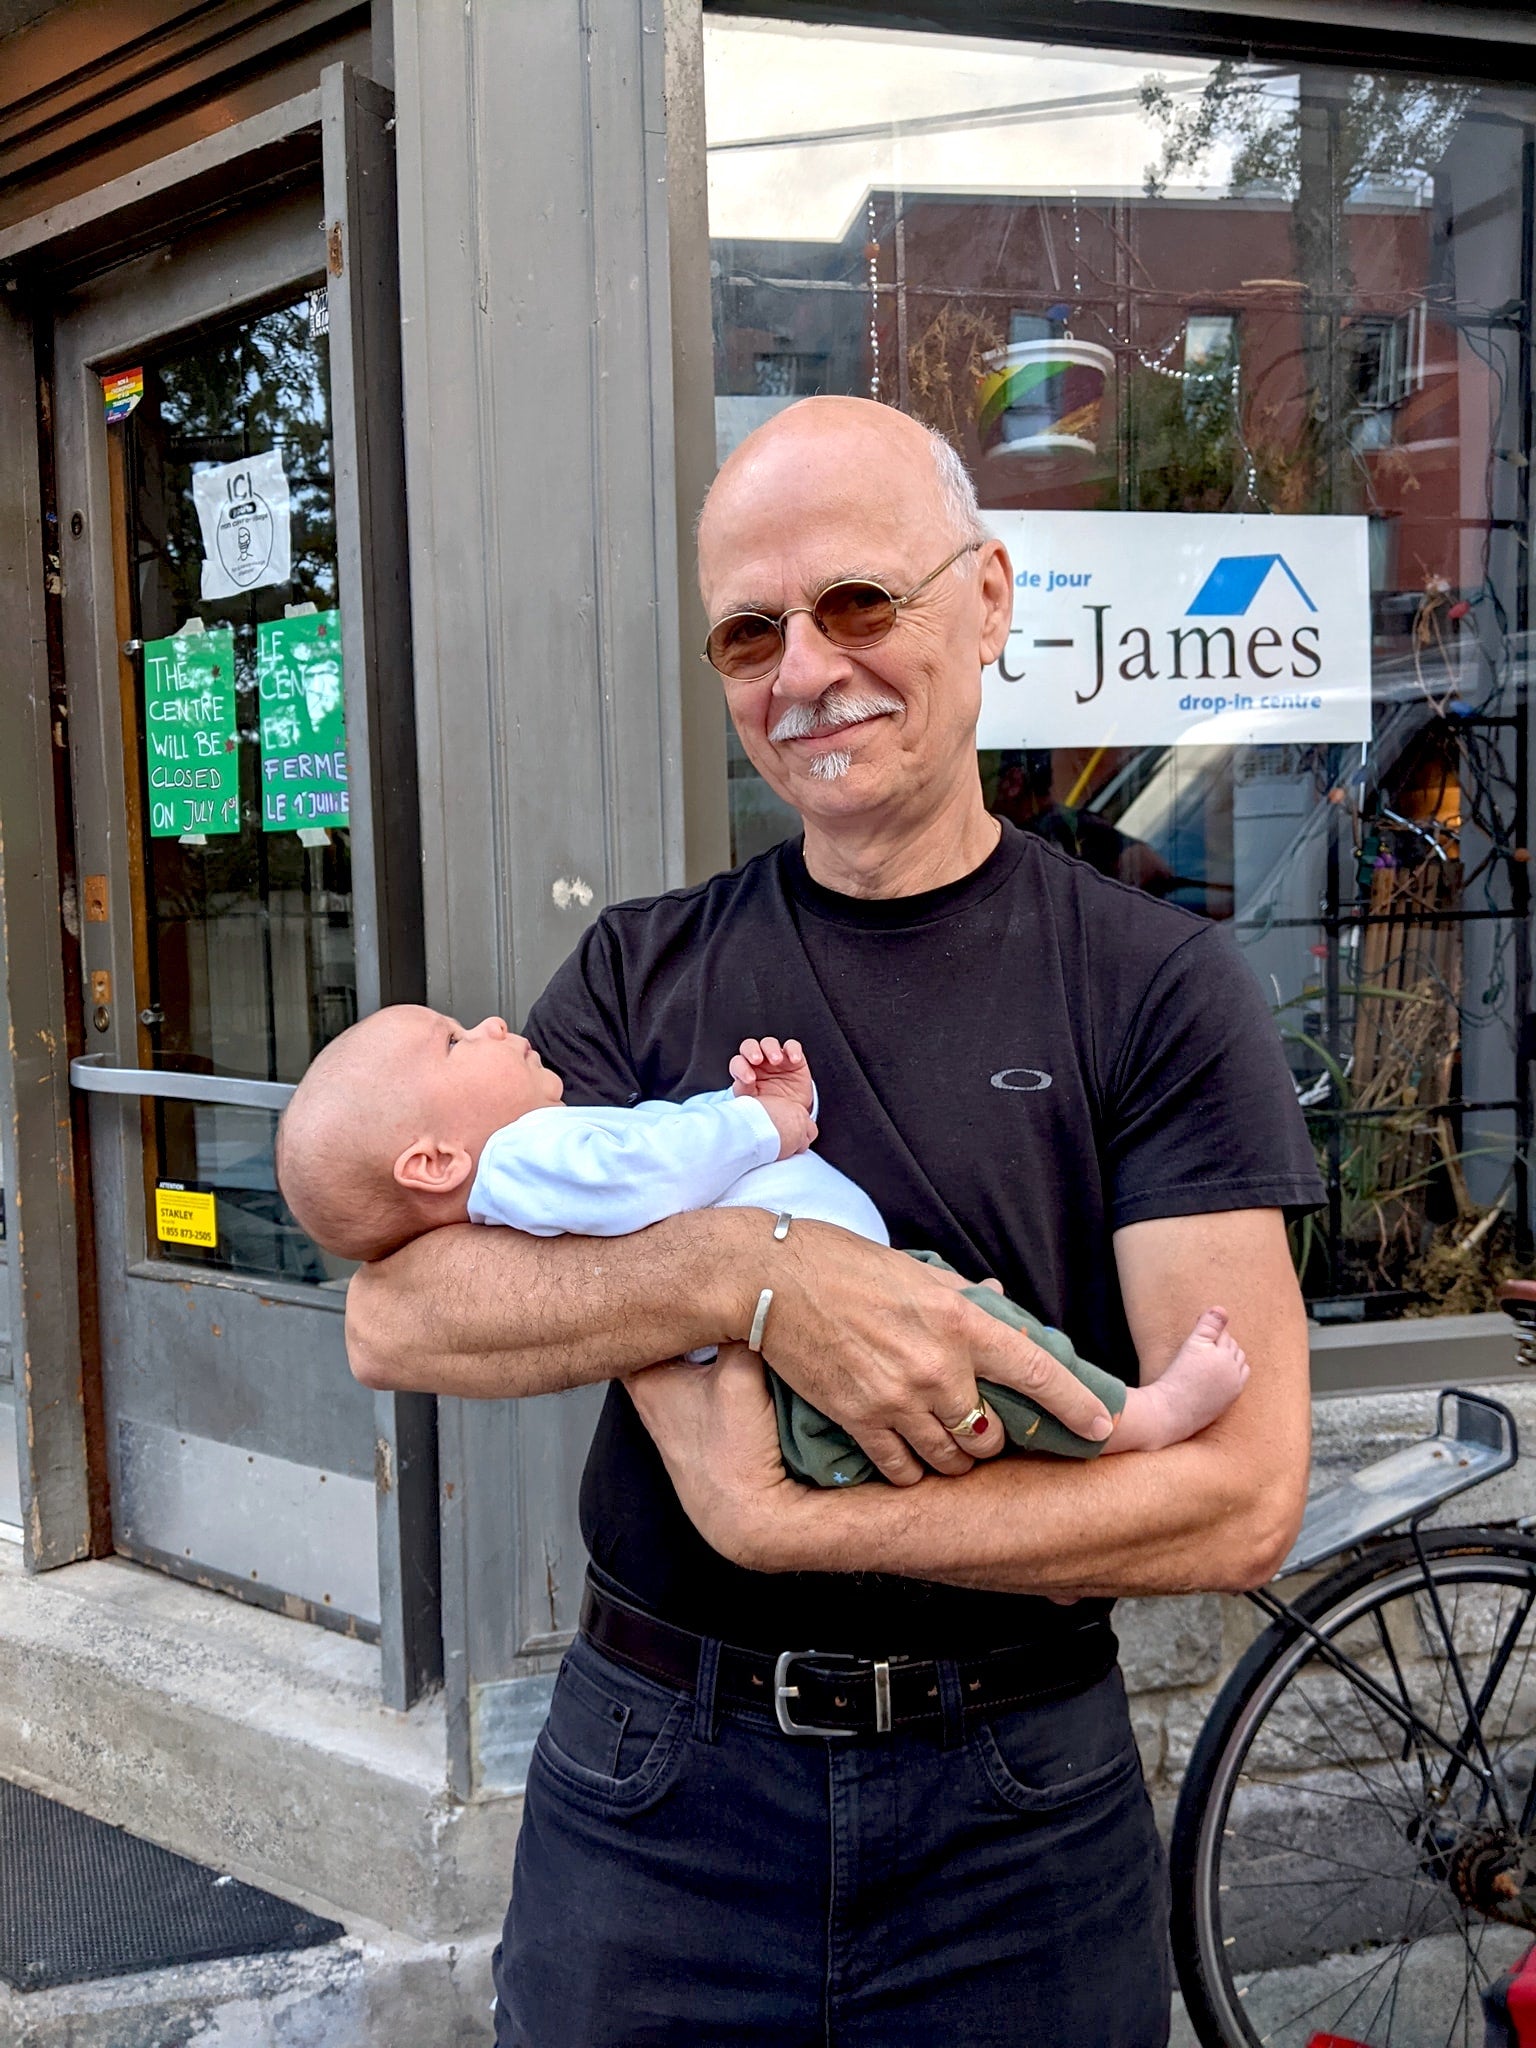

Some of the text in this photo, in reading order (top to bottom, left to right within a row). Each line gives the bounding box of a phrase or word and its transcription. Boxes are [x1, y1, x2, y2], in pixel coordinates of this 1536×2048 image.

[227, 472, 253, 502] ICI
[1015, 571, 1092, 592] de jour
[260, 631, 284, 662] LE
[998, 604, 1322, 705] t-James
[148, 656, 191, 692] THE
[149, 696, 224, 721] CENTRE
[1179, 693, 1323, 714] drop-in centre
[193, 731, 222, 756] BE
[151, 766, 221, 788] CLOSED
[153, 802, 174, 829] ON
[183, 800, 214, 831] JULY
[266, 794, 286, 821] LE
